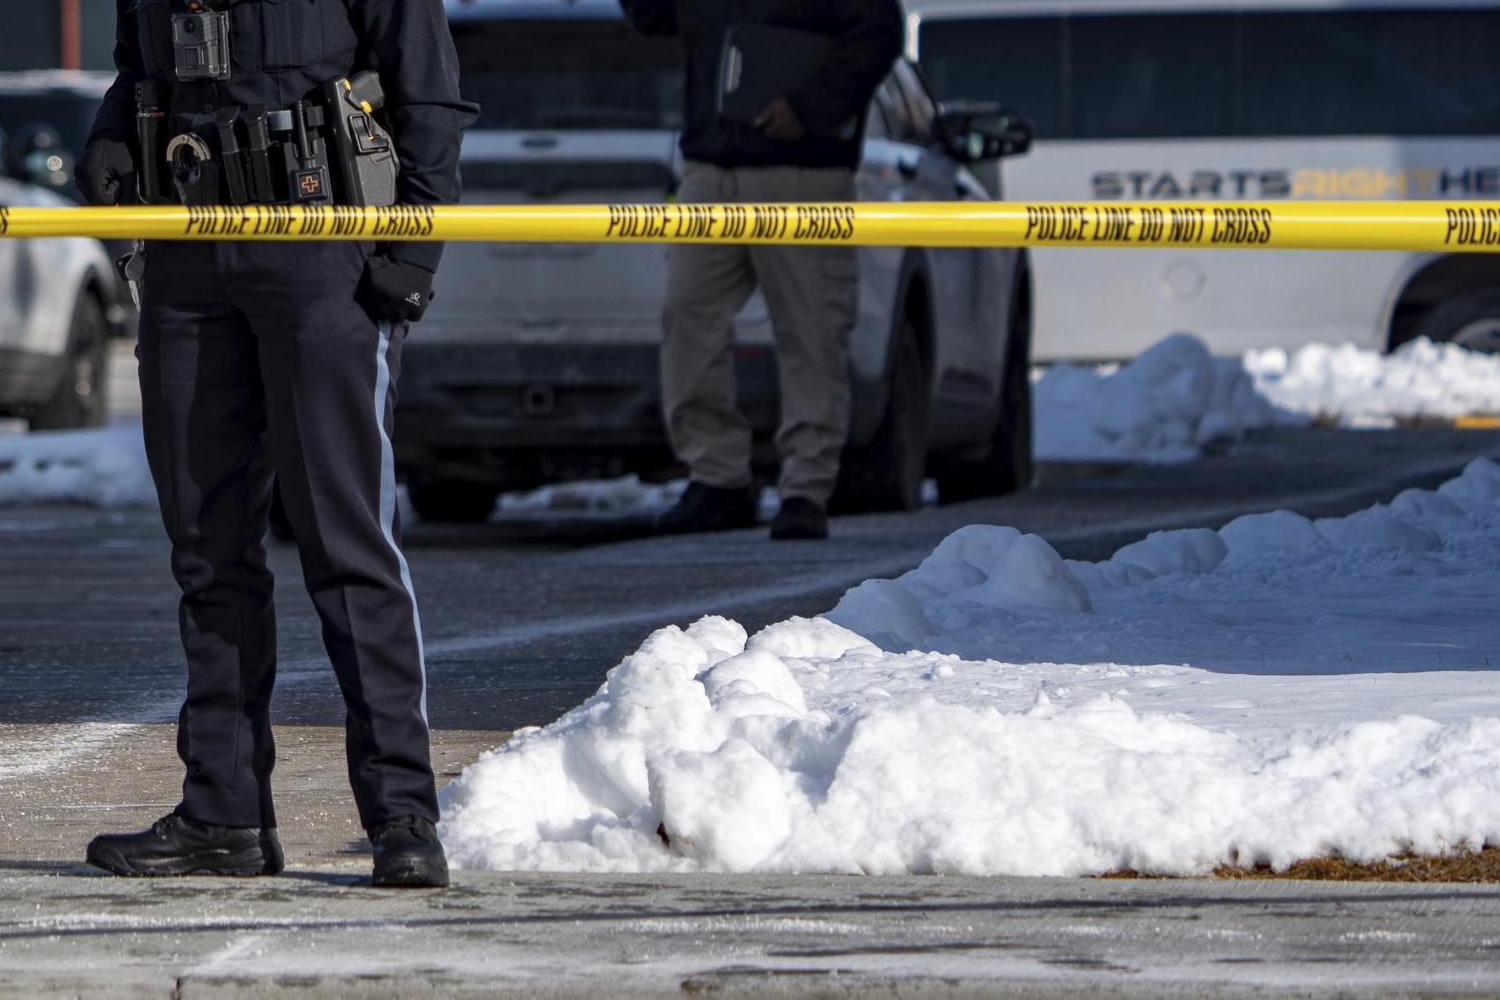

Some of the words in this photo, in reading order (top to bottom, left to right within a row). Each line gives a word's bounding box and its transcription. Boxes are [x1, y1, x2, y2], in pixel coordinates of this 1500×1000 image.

[185, 206, 250, 234] POLICE
[253, 206, 296, 234] LINE
[300, 206, 326, 234] DO
[330, 205, 367, 235] NOT
[373, 205, 435, 235] CROSS
[606, 205, 671, 237] POLICE
[675, 205, 717, 237] LINE
[721, 205, 747, 237] DO
[751, 206, 790, 239] NOT
[794, 206, 855, 239] CROSS
[1024, 206, 1089, 240] POLICE
[1092, 206, 1134, 240] LINE
[1138, 207, 1164, 242] DO
[1168, 207, 1206, 242] NOT
[1211, 208, 1272, 244] CROSS
[1444, 208, 1500, 244] POLIC
